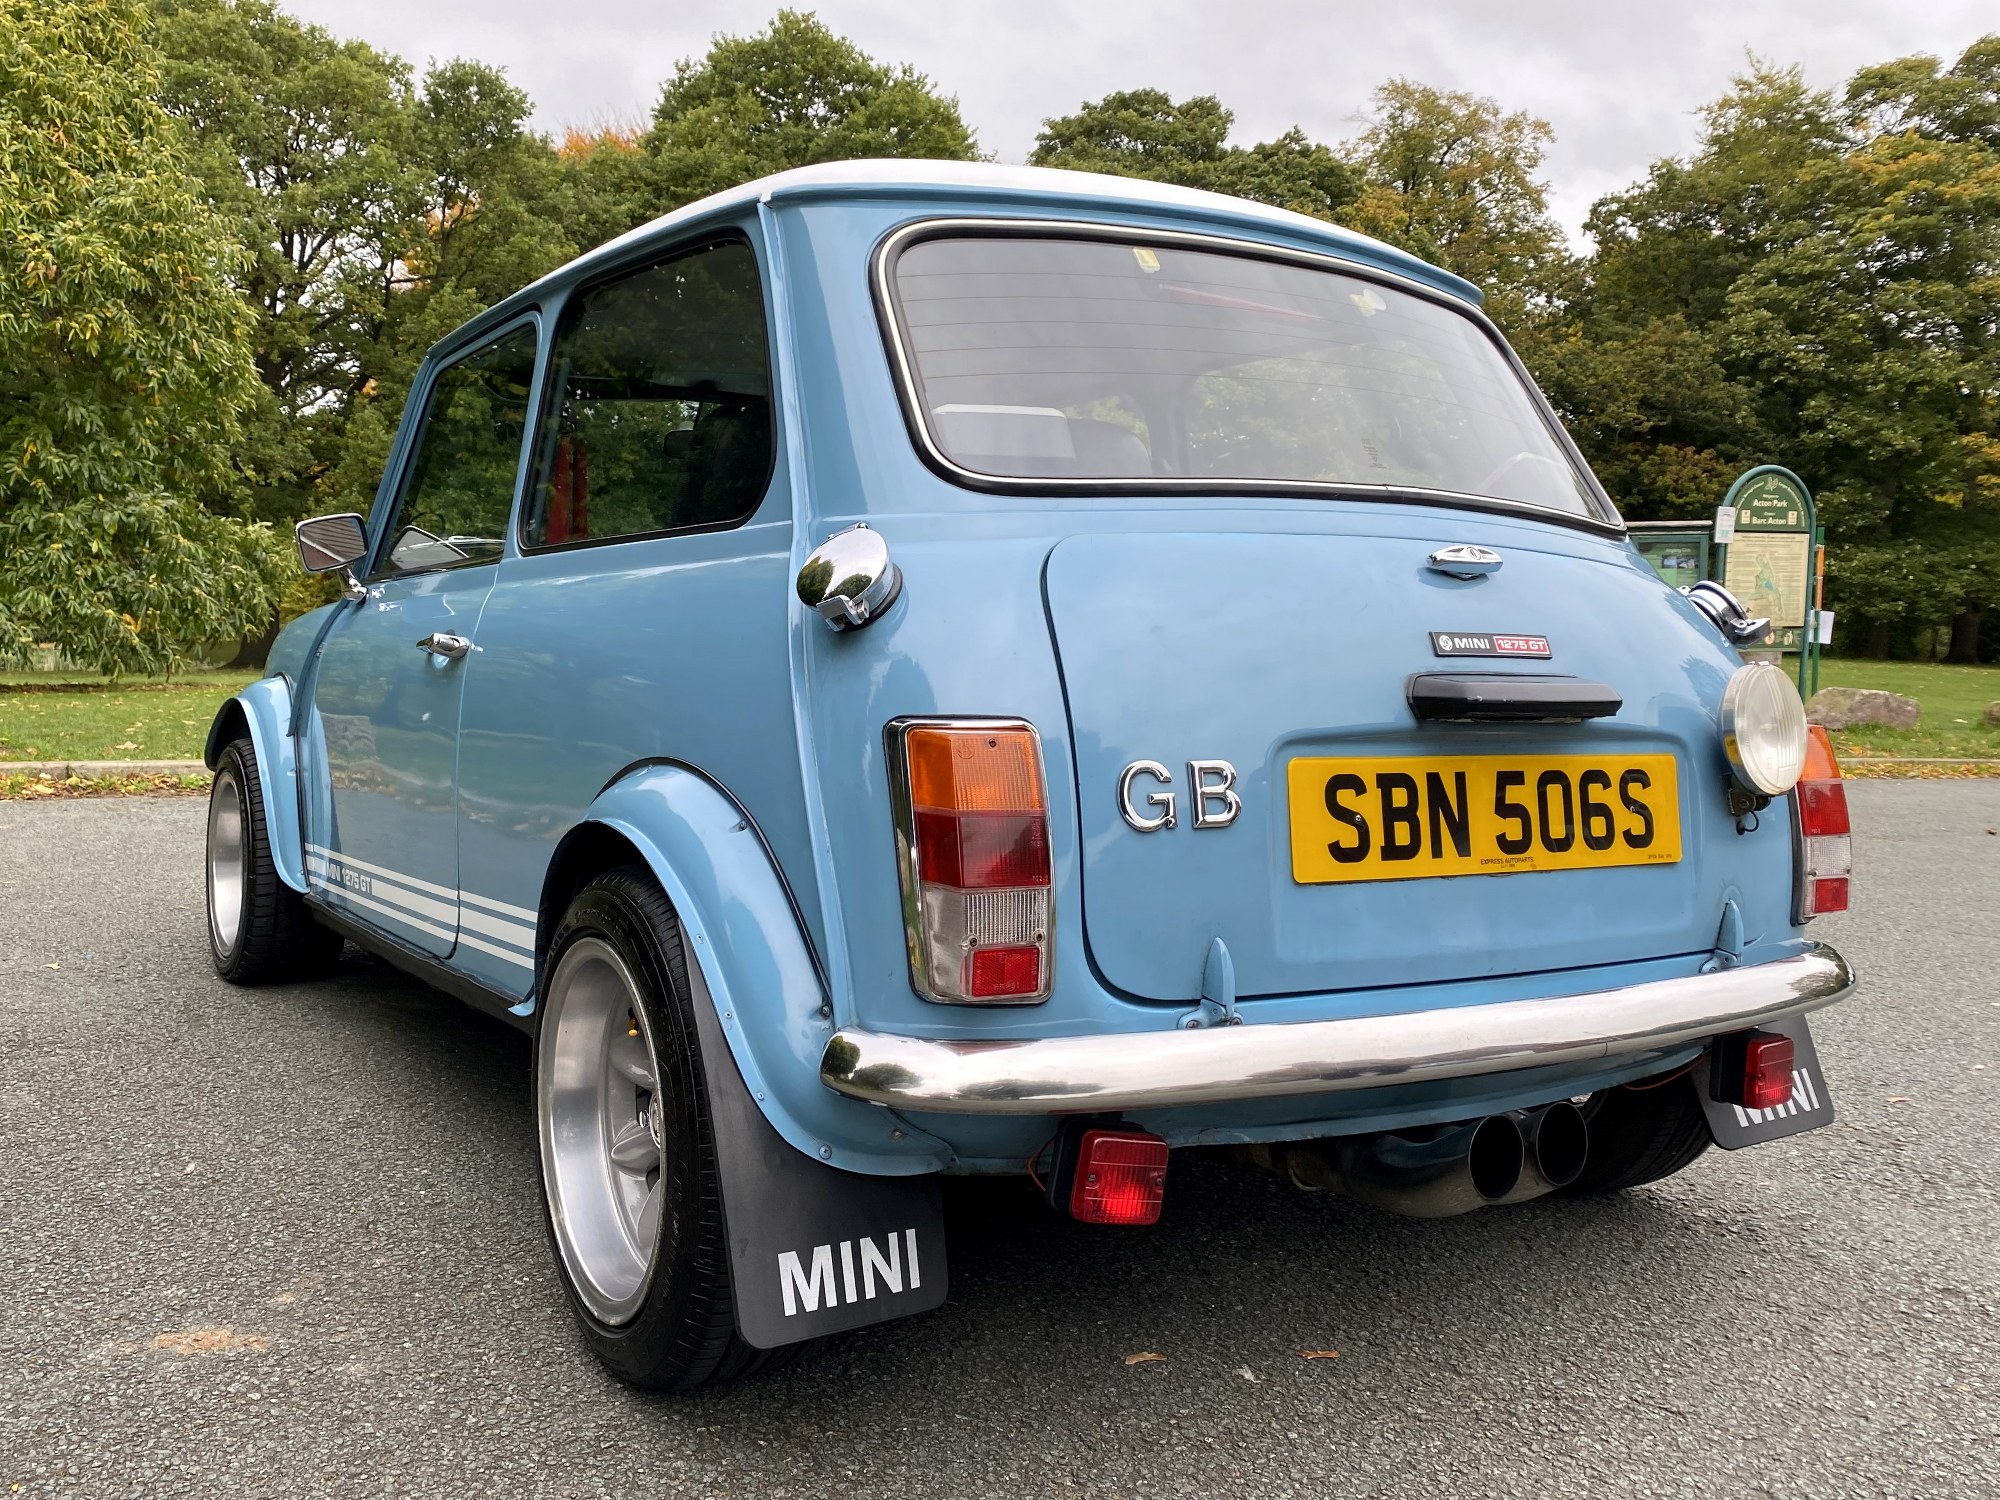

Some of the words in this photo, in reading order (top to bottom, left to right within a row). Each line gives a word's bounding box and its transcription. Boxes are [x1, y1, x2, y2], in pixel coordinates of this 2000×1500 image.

[1753, 499, 1772, 507] Acton
[1773, 499, 1788, 508] Park
[1752, 516, 1767, 524] Barc
[1768, 517, 1787, 525] Acton
[1454, 638, 1490, 649] MINI
[1497, 640, 1528, 650] 1275
[1528, 641, 1545, 651] GT
[1117, 759, 1242, 833] GB
[1324, 771, 1472, 863] SBN
[1494, 768, 1655, 856] 506S
[1480, 858, 1504, 866] EXPRESS
[1504, 856, 1534, 865] AUTOPARTS
[341, 868, 360, 889] 1275
[360, 875, 371, 894] GT
[777, 1228, 921, 1317] MINI
